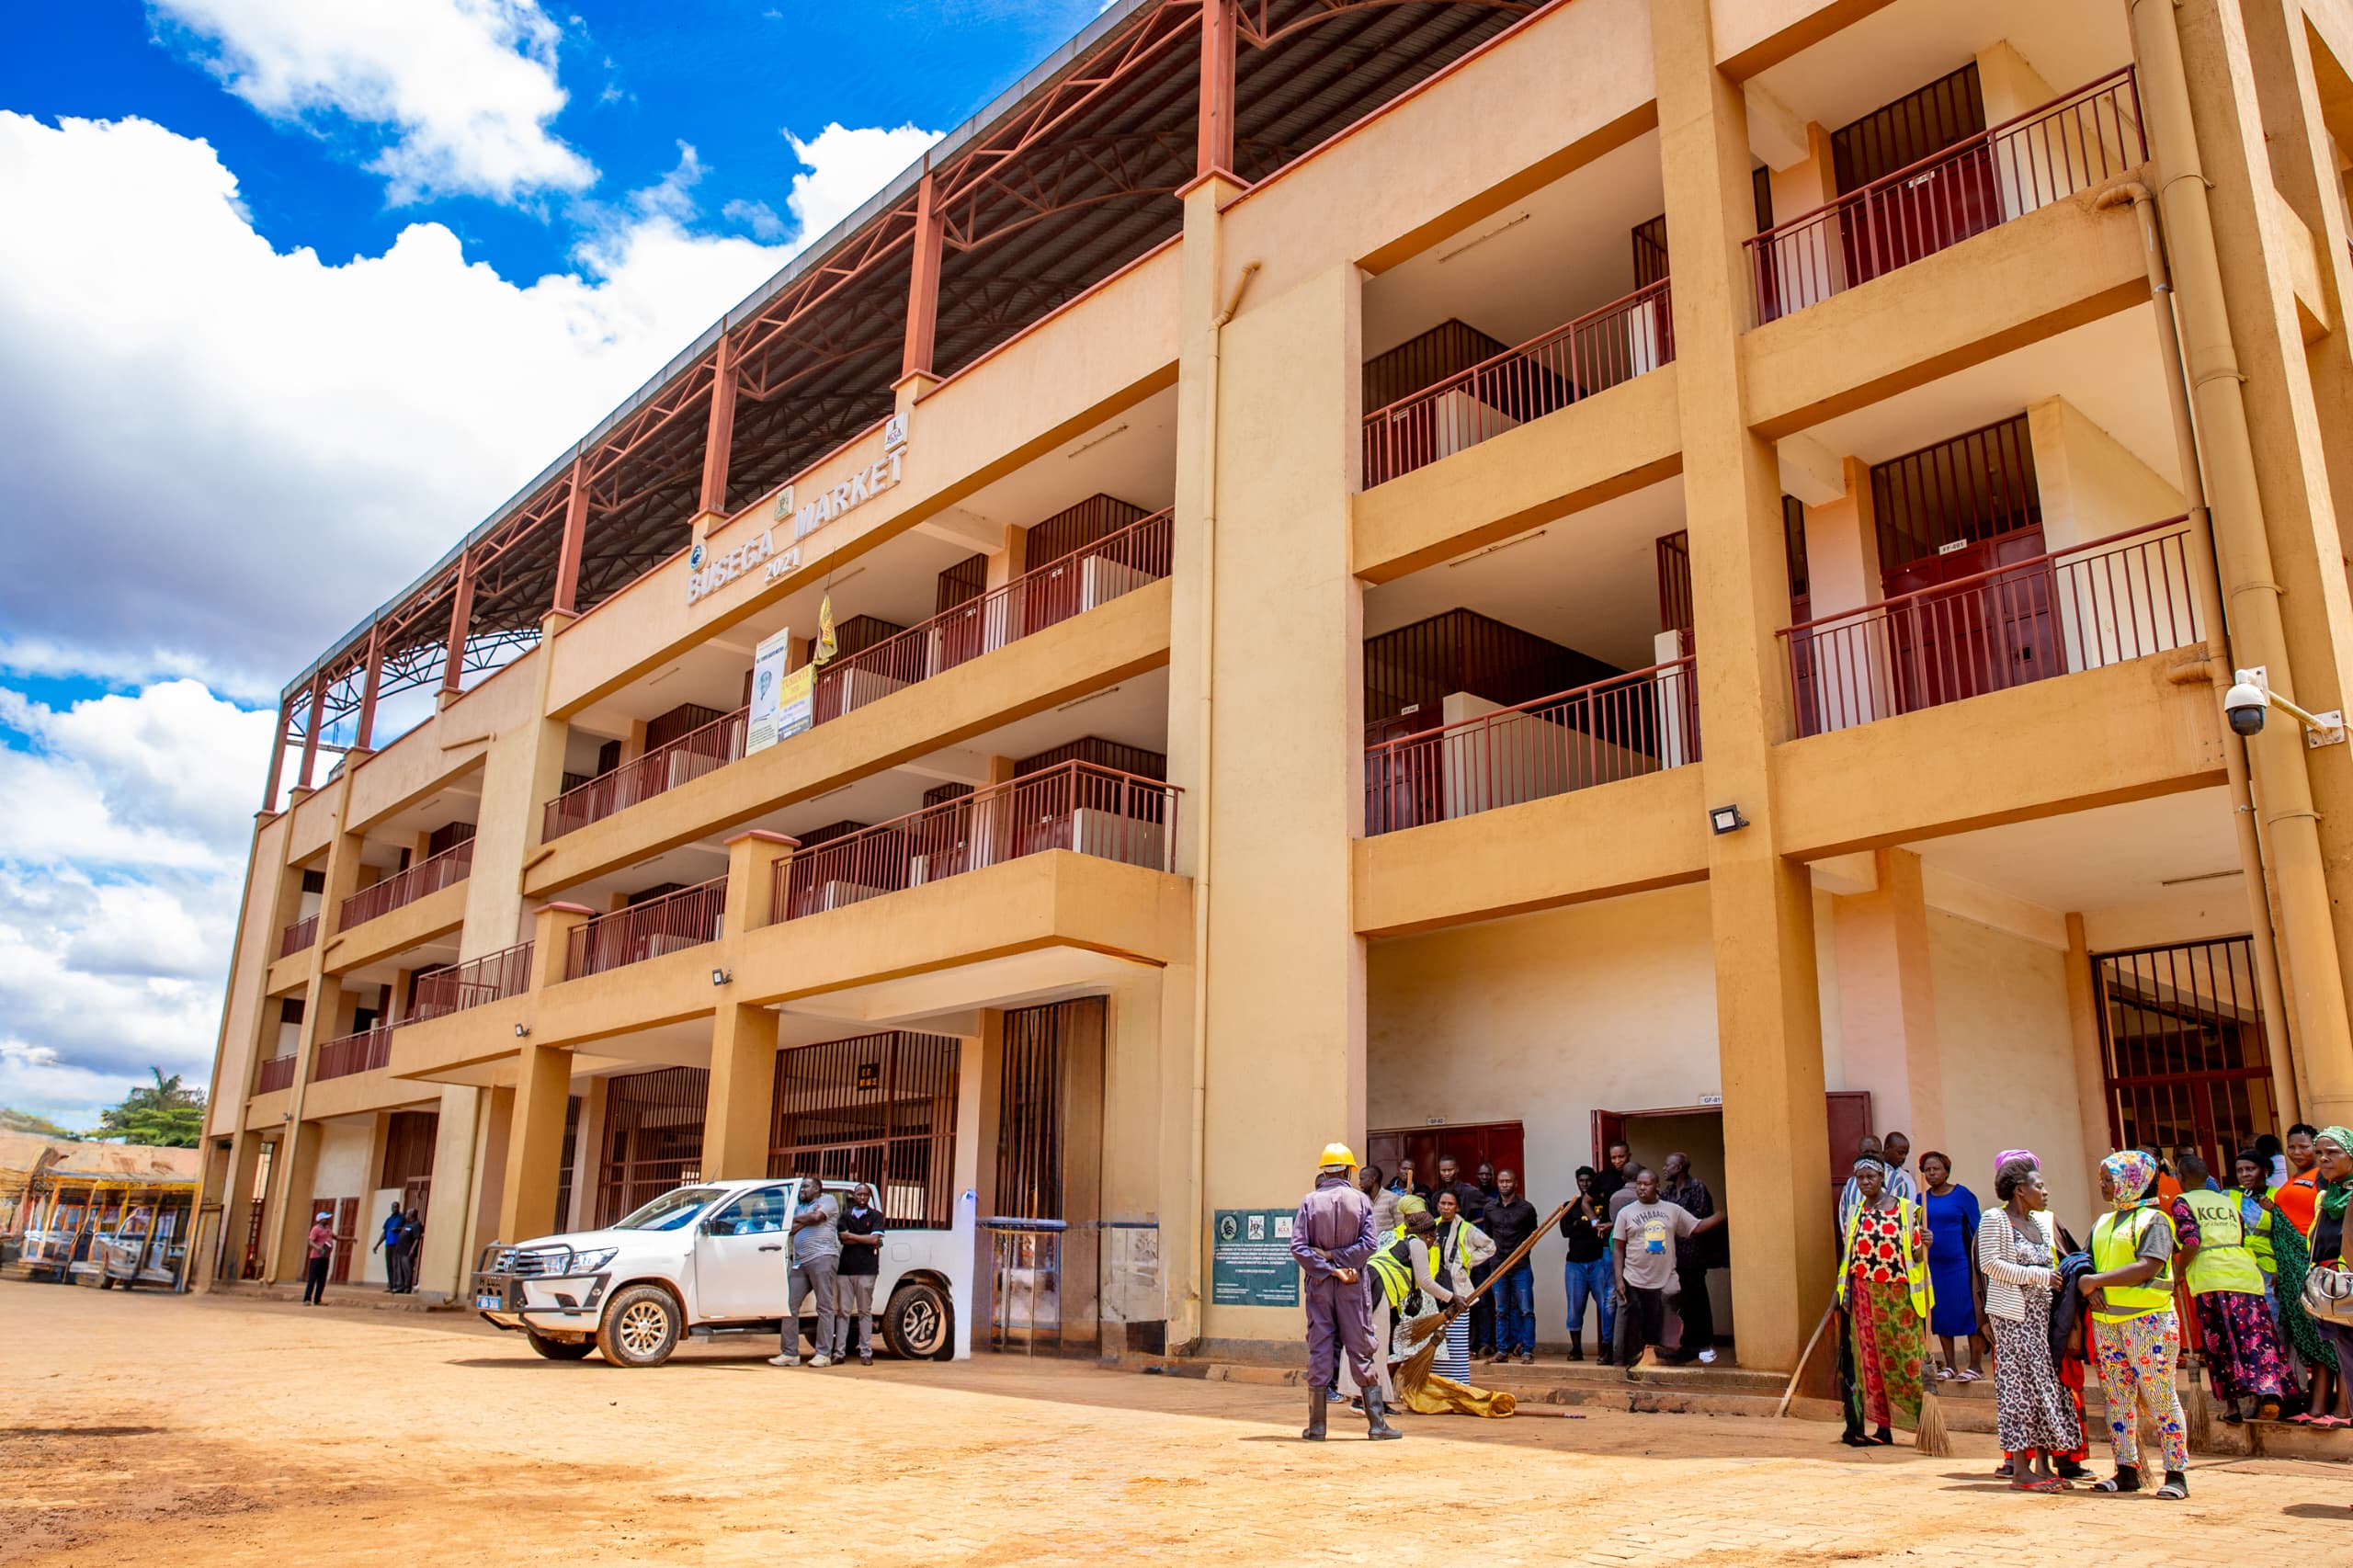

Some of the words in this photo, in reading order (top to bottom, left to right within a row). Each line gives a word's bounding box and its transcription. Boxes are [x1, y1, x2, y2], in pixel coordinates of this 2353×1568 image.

[688, 529, 773, 606] BUSEGA
[794, 446, 906, 541] MARKET
[765, 548, 800, 584] 2021
[2197, 1207, 2237, 1222] KCCA
